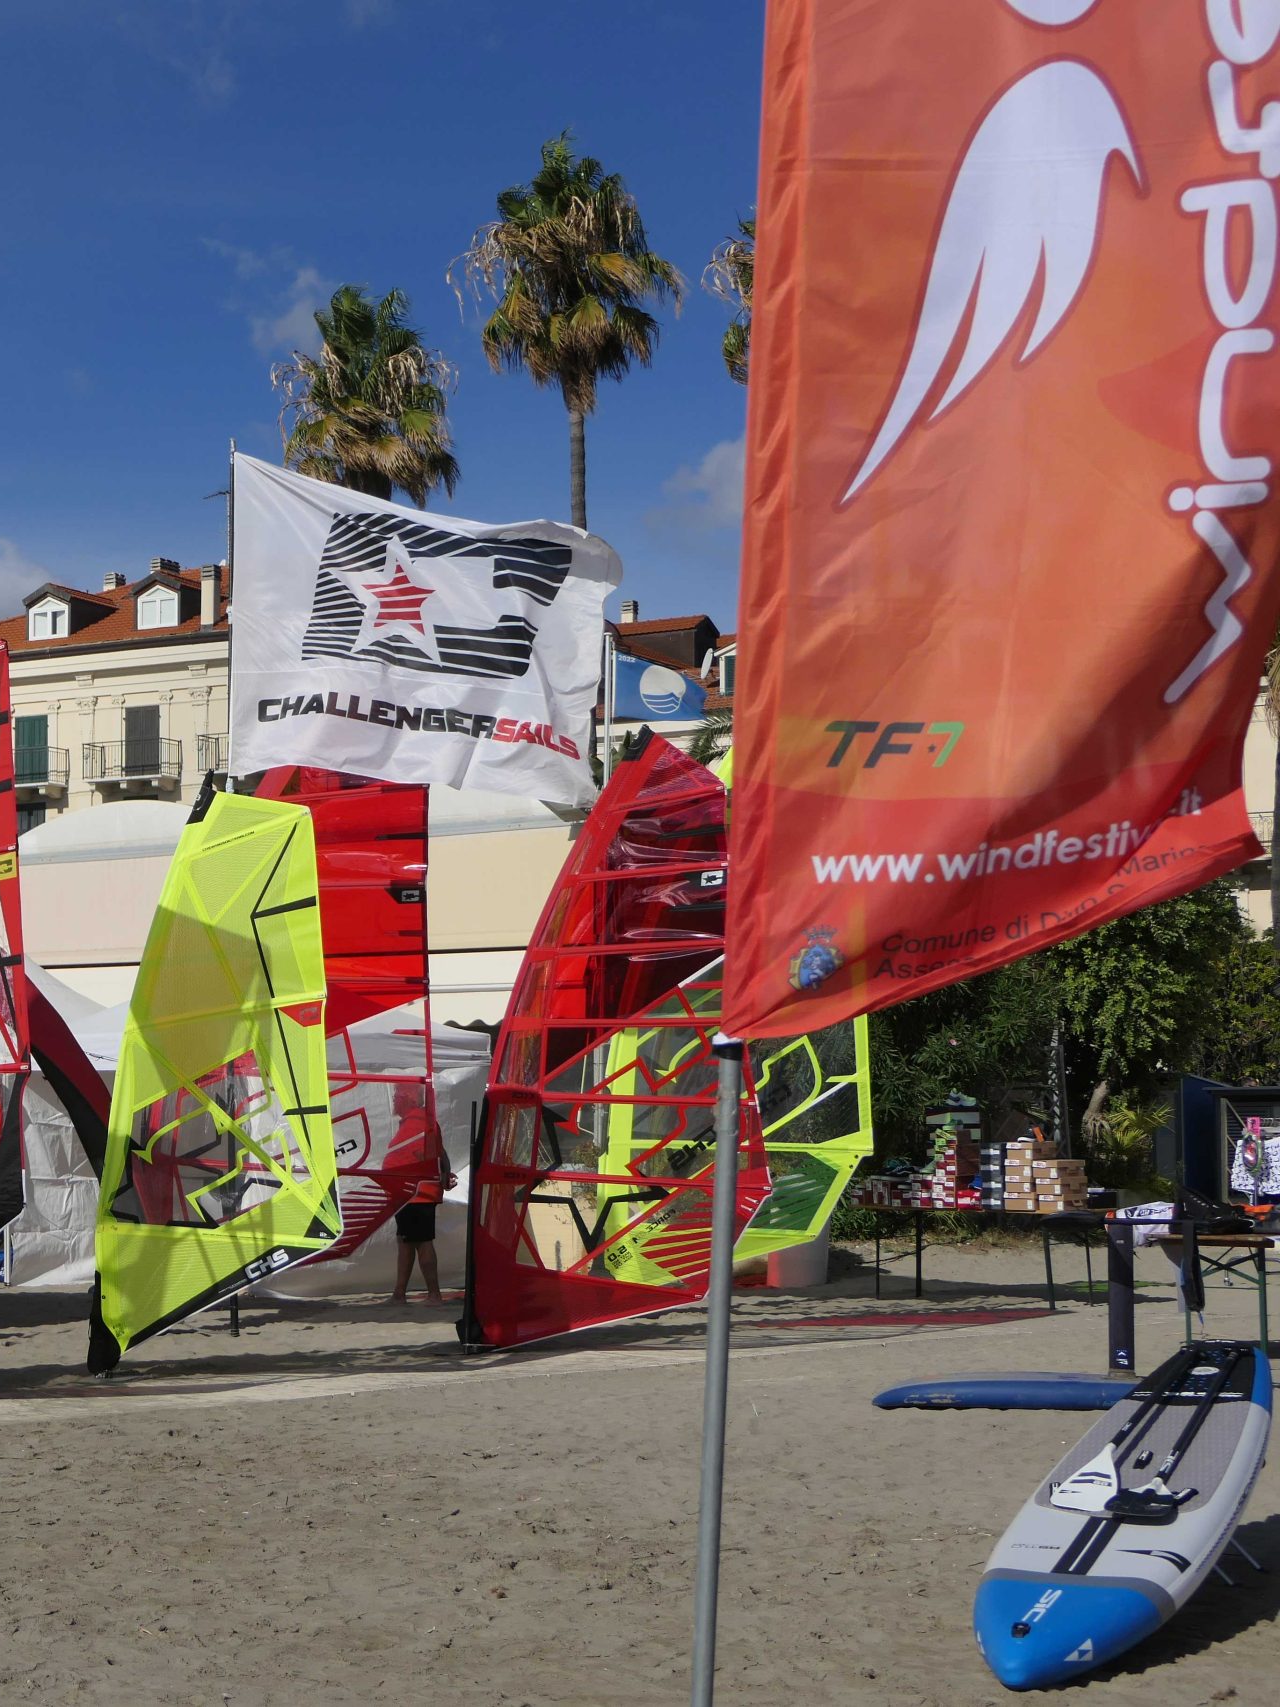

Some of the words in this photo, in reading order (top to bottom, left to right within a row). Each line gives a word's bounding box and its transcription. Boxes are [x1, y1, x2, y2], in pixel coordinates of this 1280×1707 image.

[617, 654, 636, 663] 2022
[258, 691, 581, 761] CHALLENGERSAILS
[811, 787, 1203, 884] www.windfestiv.it
[881, 925, 996, 955] Comune
[1005, 914, 1030, 940] di
[244, 1248, 289, 1280] CHS
[1021, 1589, 1063, 1622] SIC
